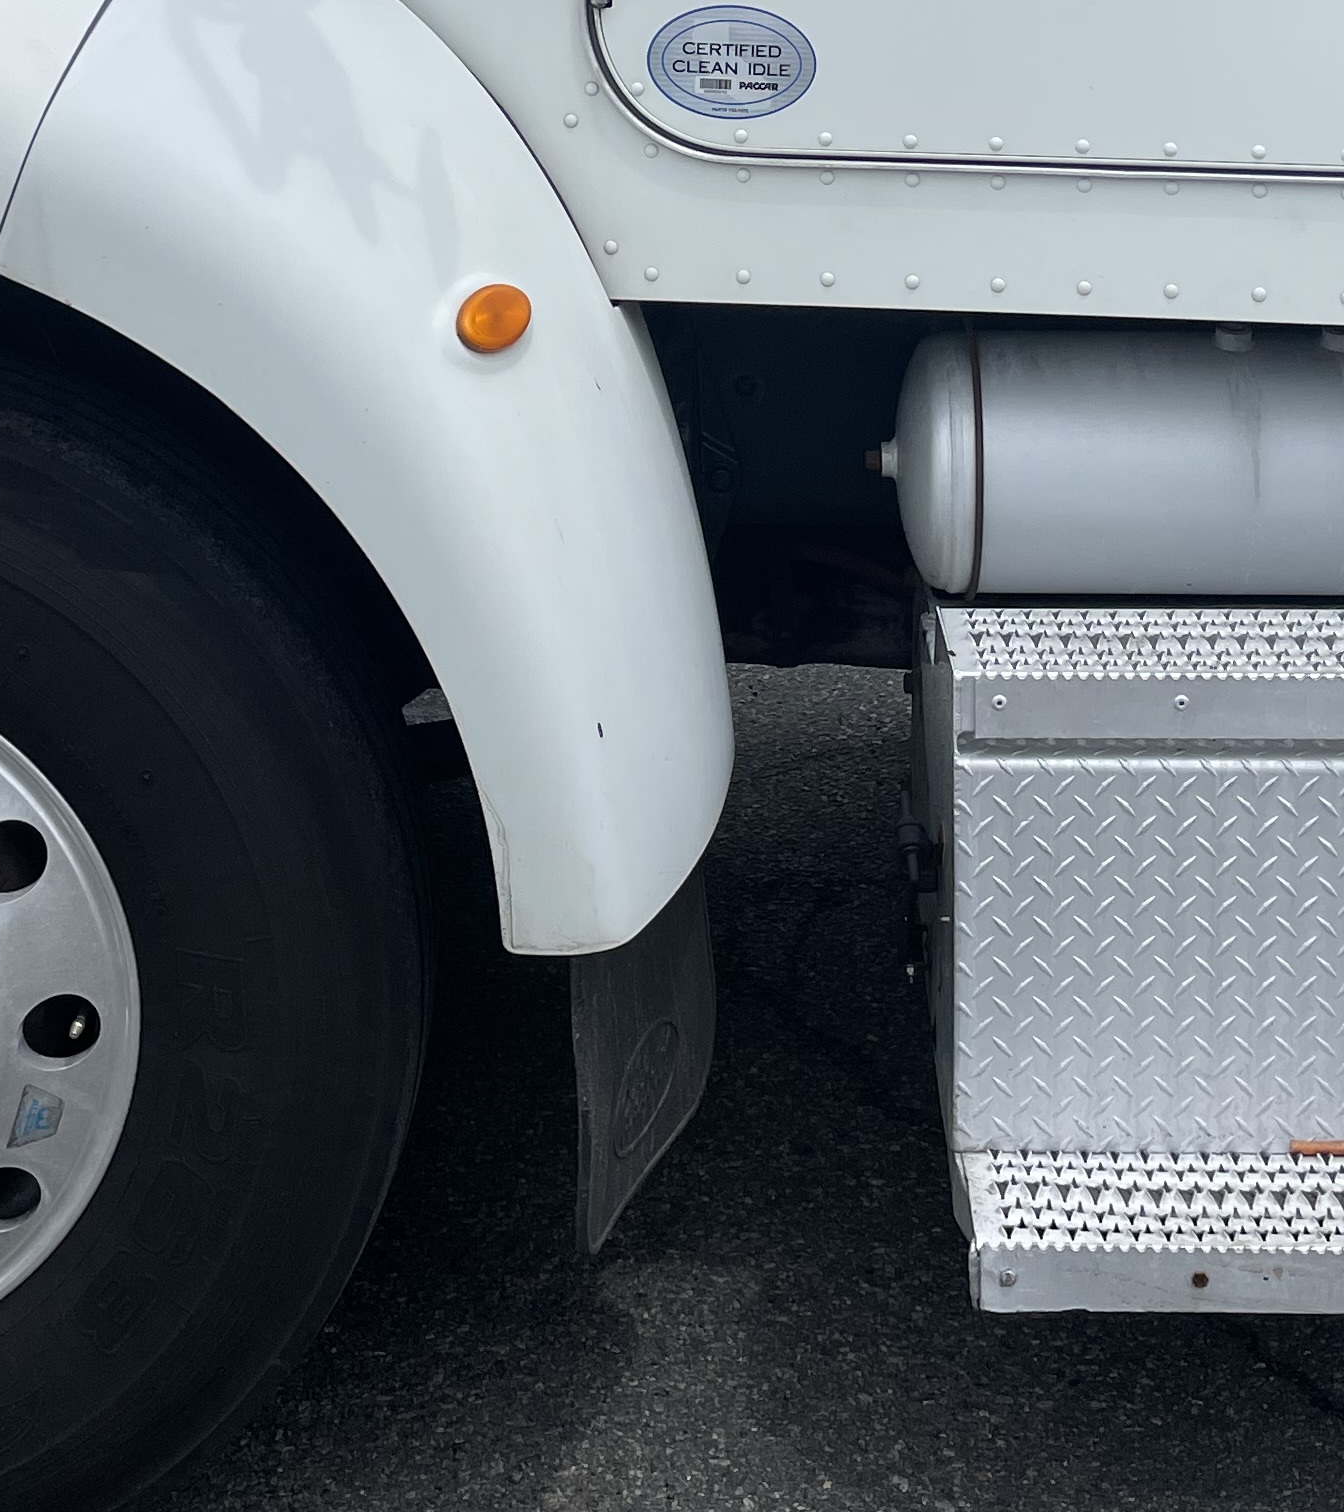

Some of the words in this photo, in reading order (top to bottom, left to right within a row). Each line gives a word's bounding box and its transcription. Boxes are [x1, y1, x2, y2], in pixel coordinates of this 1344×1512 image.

[681, 41, 783, 59] CERTIFIED
[672, 59, 739, 76] CLEAN
[747, 61, 792, 78] IDLE
[738, 80, 779, 92] PACCAR
